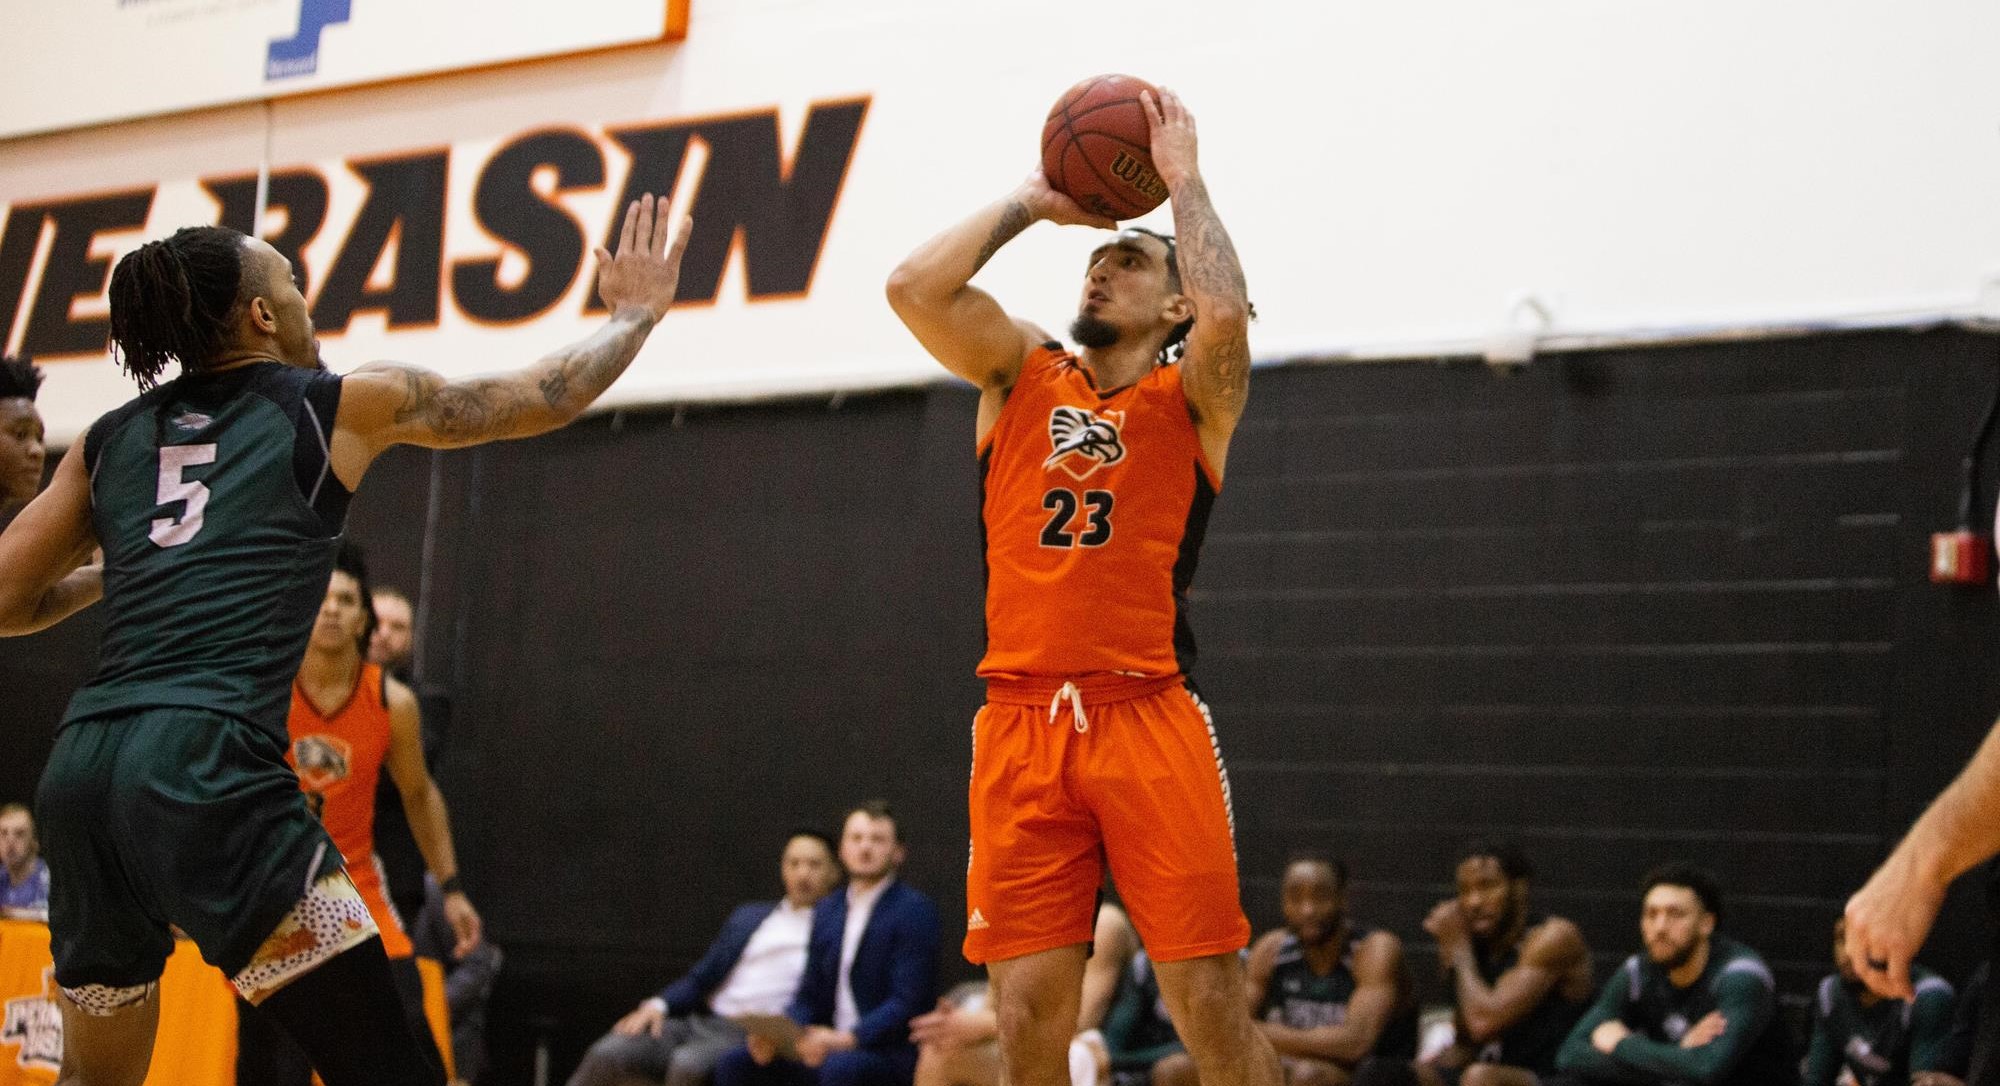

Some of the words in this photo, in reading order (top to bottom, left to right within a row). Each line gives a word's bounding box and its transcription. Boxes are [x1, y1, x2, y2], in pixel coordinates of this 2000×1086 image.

[1110, 150, 1169, 198] Wils
[200, 95, 873, 339] BASIN
[148, 443, 218, 548] 5
[1039, 487, 1115, 549] 23
